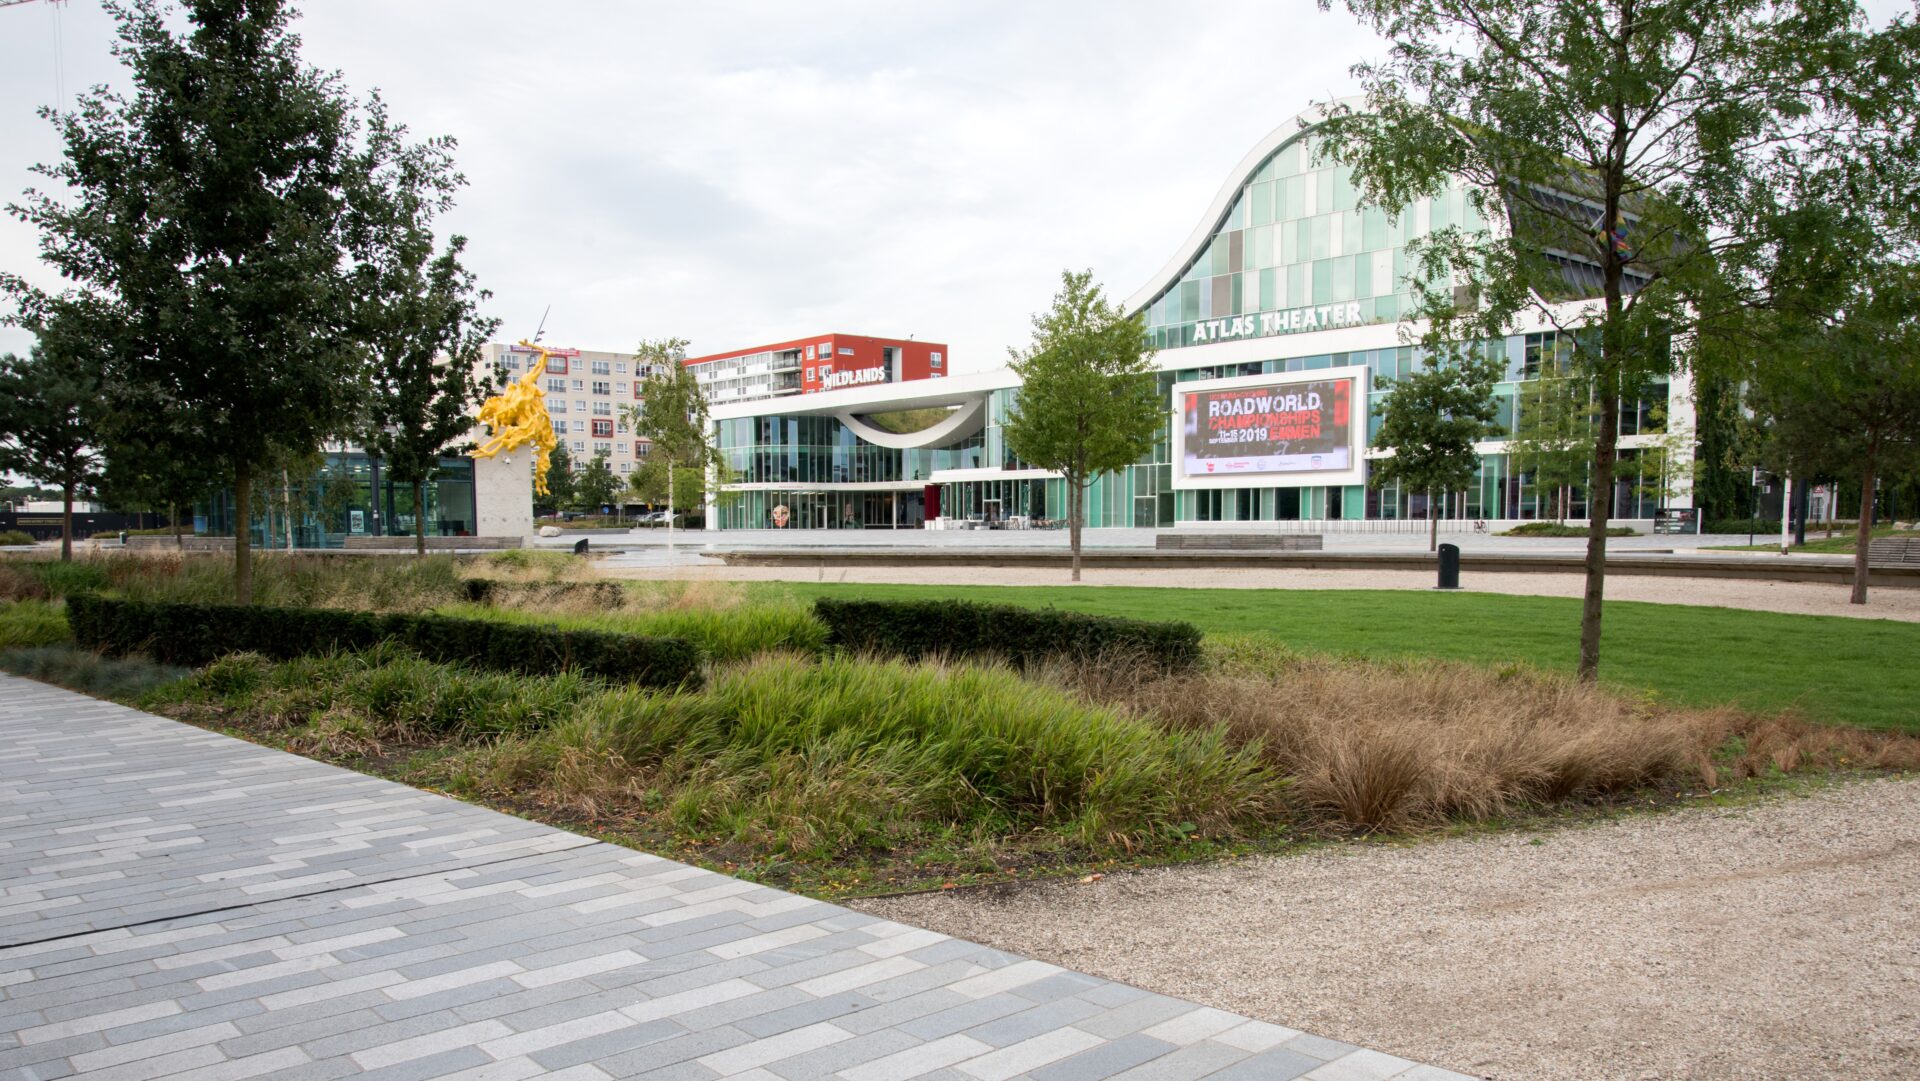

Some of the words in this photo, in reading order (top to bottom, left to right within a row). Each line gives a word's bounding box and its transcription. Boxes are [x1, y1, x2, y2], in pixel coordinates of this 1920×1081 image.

[1193, 316, 1255, 342] ATLAS
[1260, 301, 1361, 331] THEATER
[823, 366, 885, 388] WILDLANDS
[1208, 392, 1320, 416] ROADWORLD
[1208, 410, 1321, 430] CHAMPIONSHIPS
[1239, 427, 1267, 442] 2019
[1270, 424, 1321, 440] EMMEN
